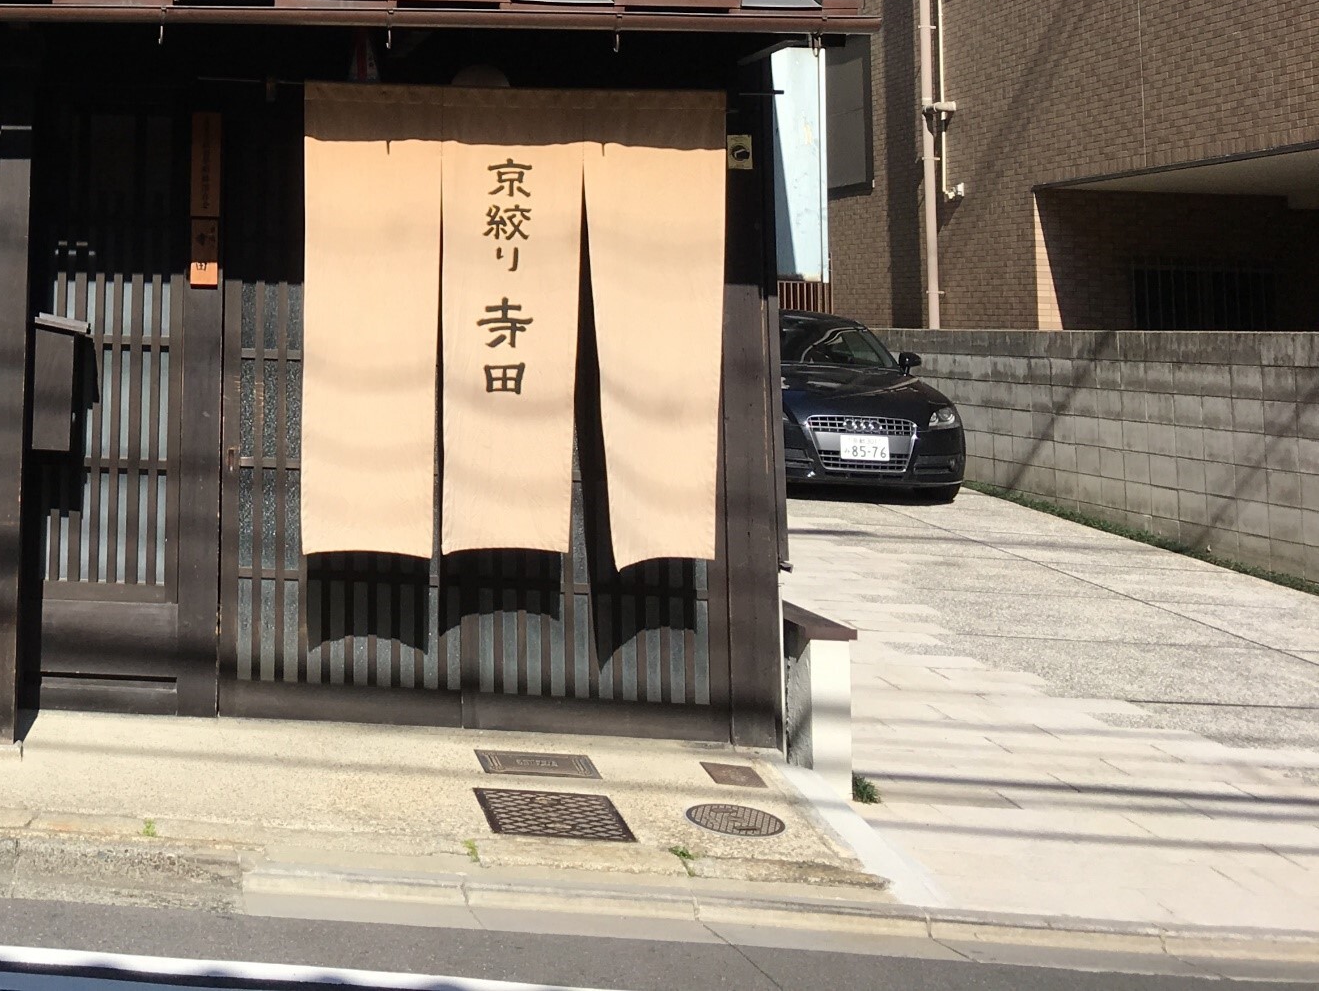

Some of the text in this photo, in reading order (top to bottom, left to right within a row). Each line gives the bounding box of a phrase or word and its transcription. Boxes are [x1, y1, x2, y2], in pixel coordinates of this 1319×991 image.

[477, 158, 533, 394] 京絞り 寺田
[852, 445, 887, 458] 85-76
